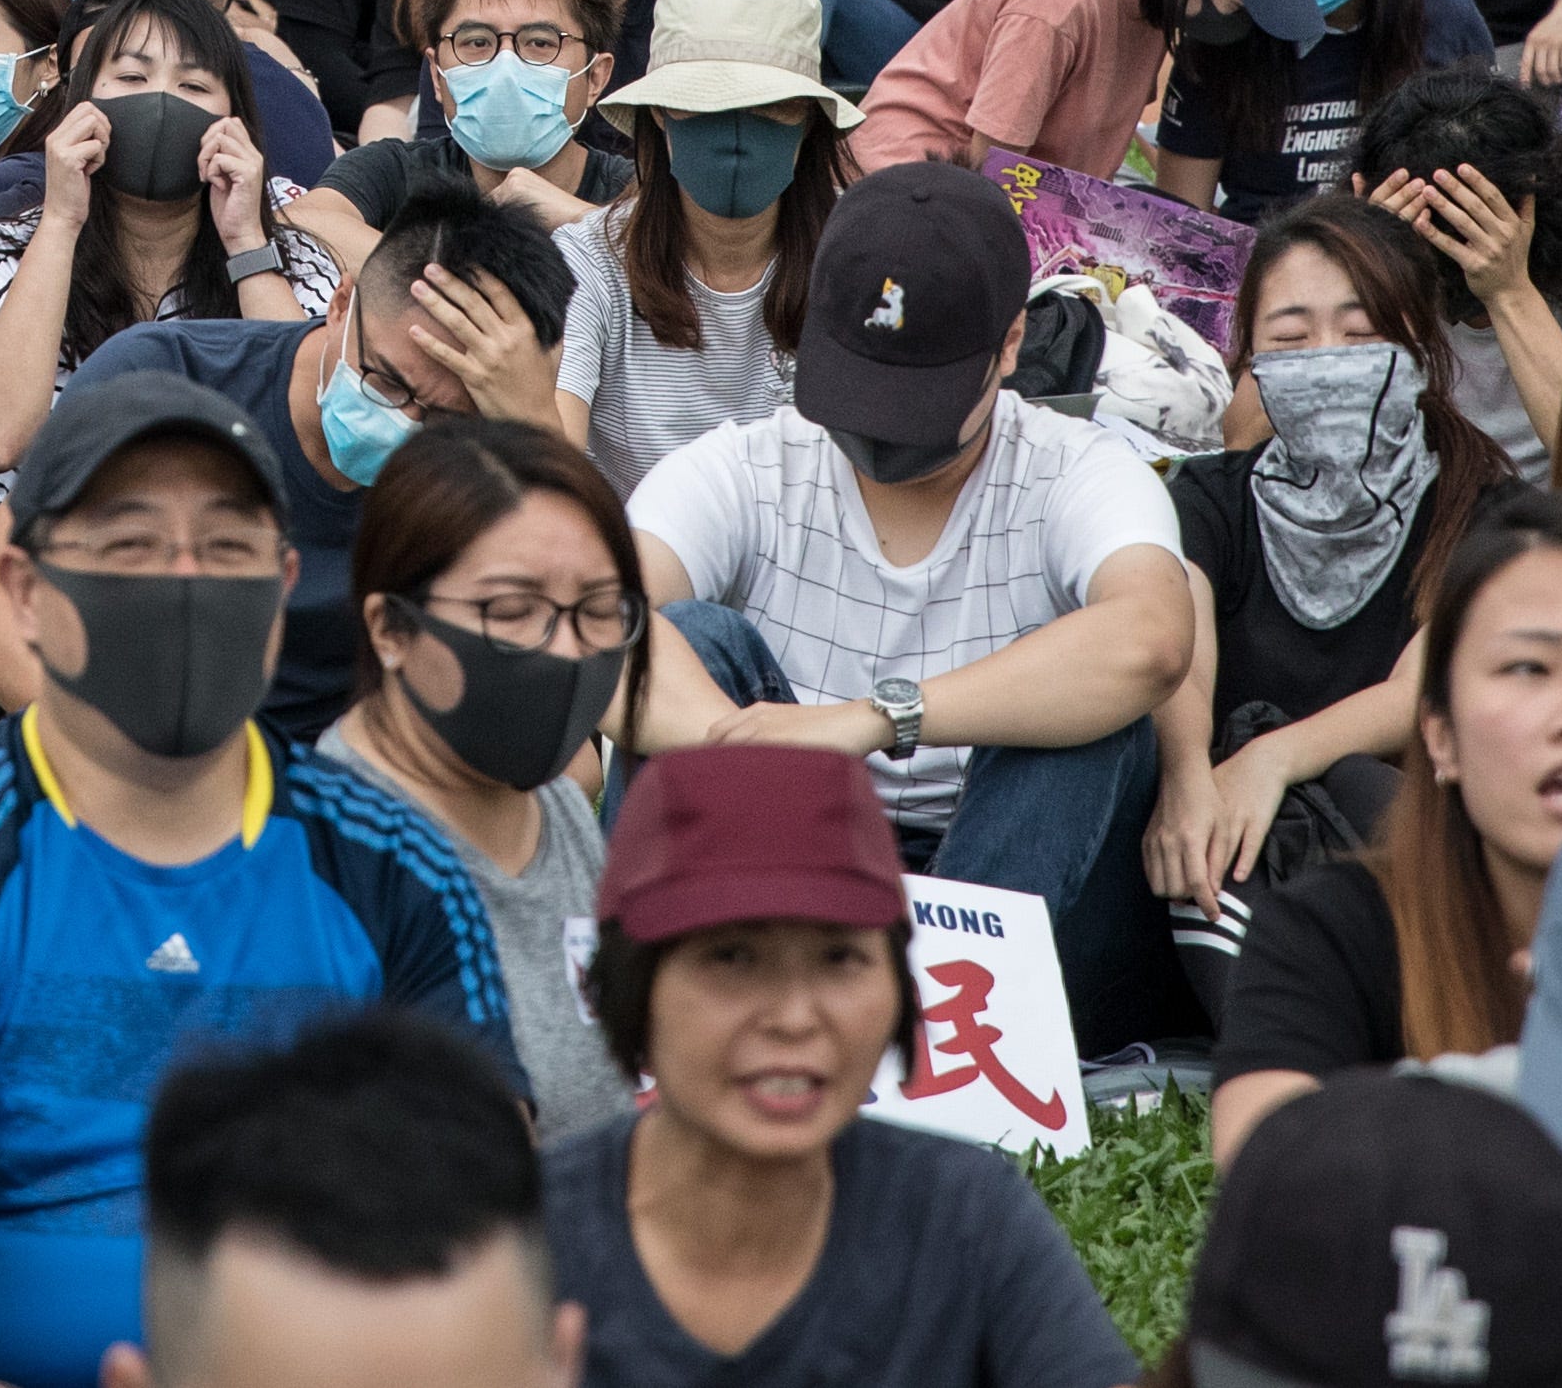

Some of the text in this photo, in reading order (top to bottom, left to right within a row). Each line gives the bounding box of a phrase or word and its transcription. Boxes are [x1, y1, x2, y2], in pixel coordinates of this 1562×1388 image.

[912, 900, 1005, 940] KONG
[898, 958, 1068, 1131] 民
[1383, 1225, 1492, 1381] LA
